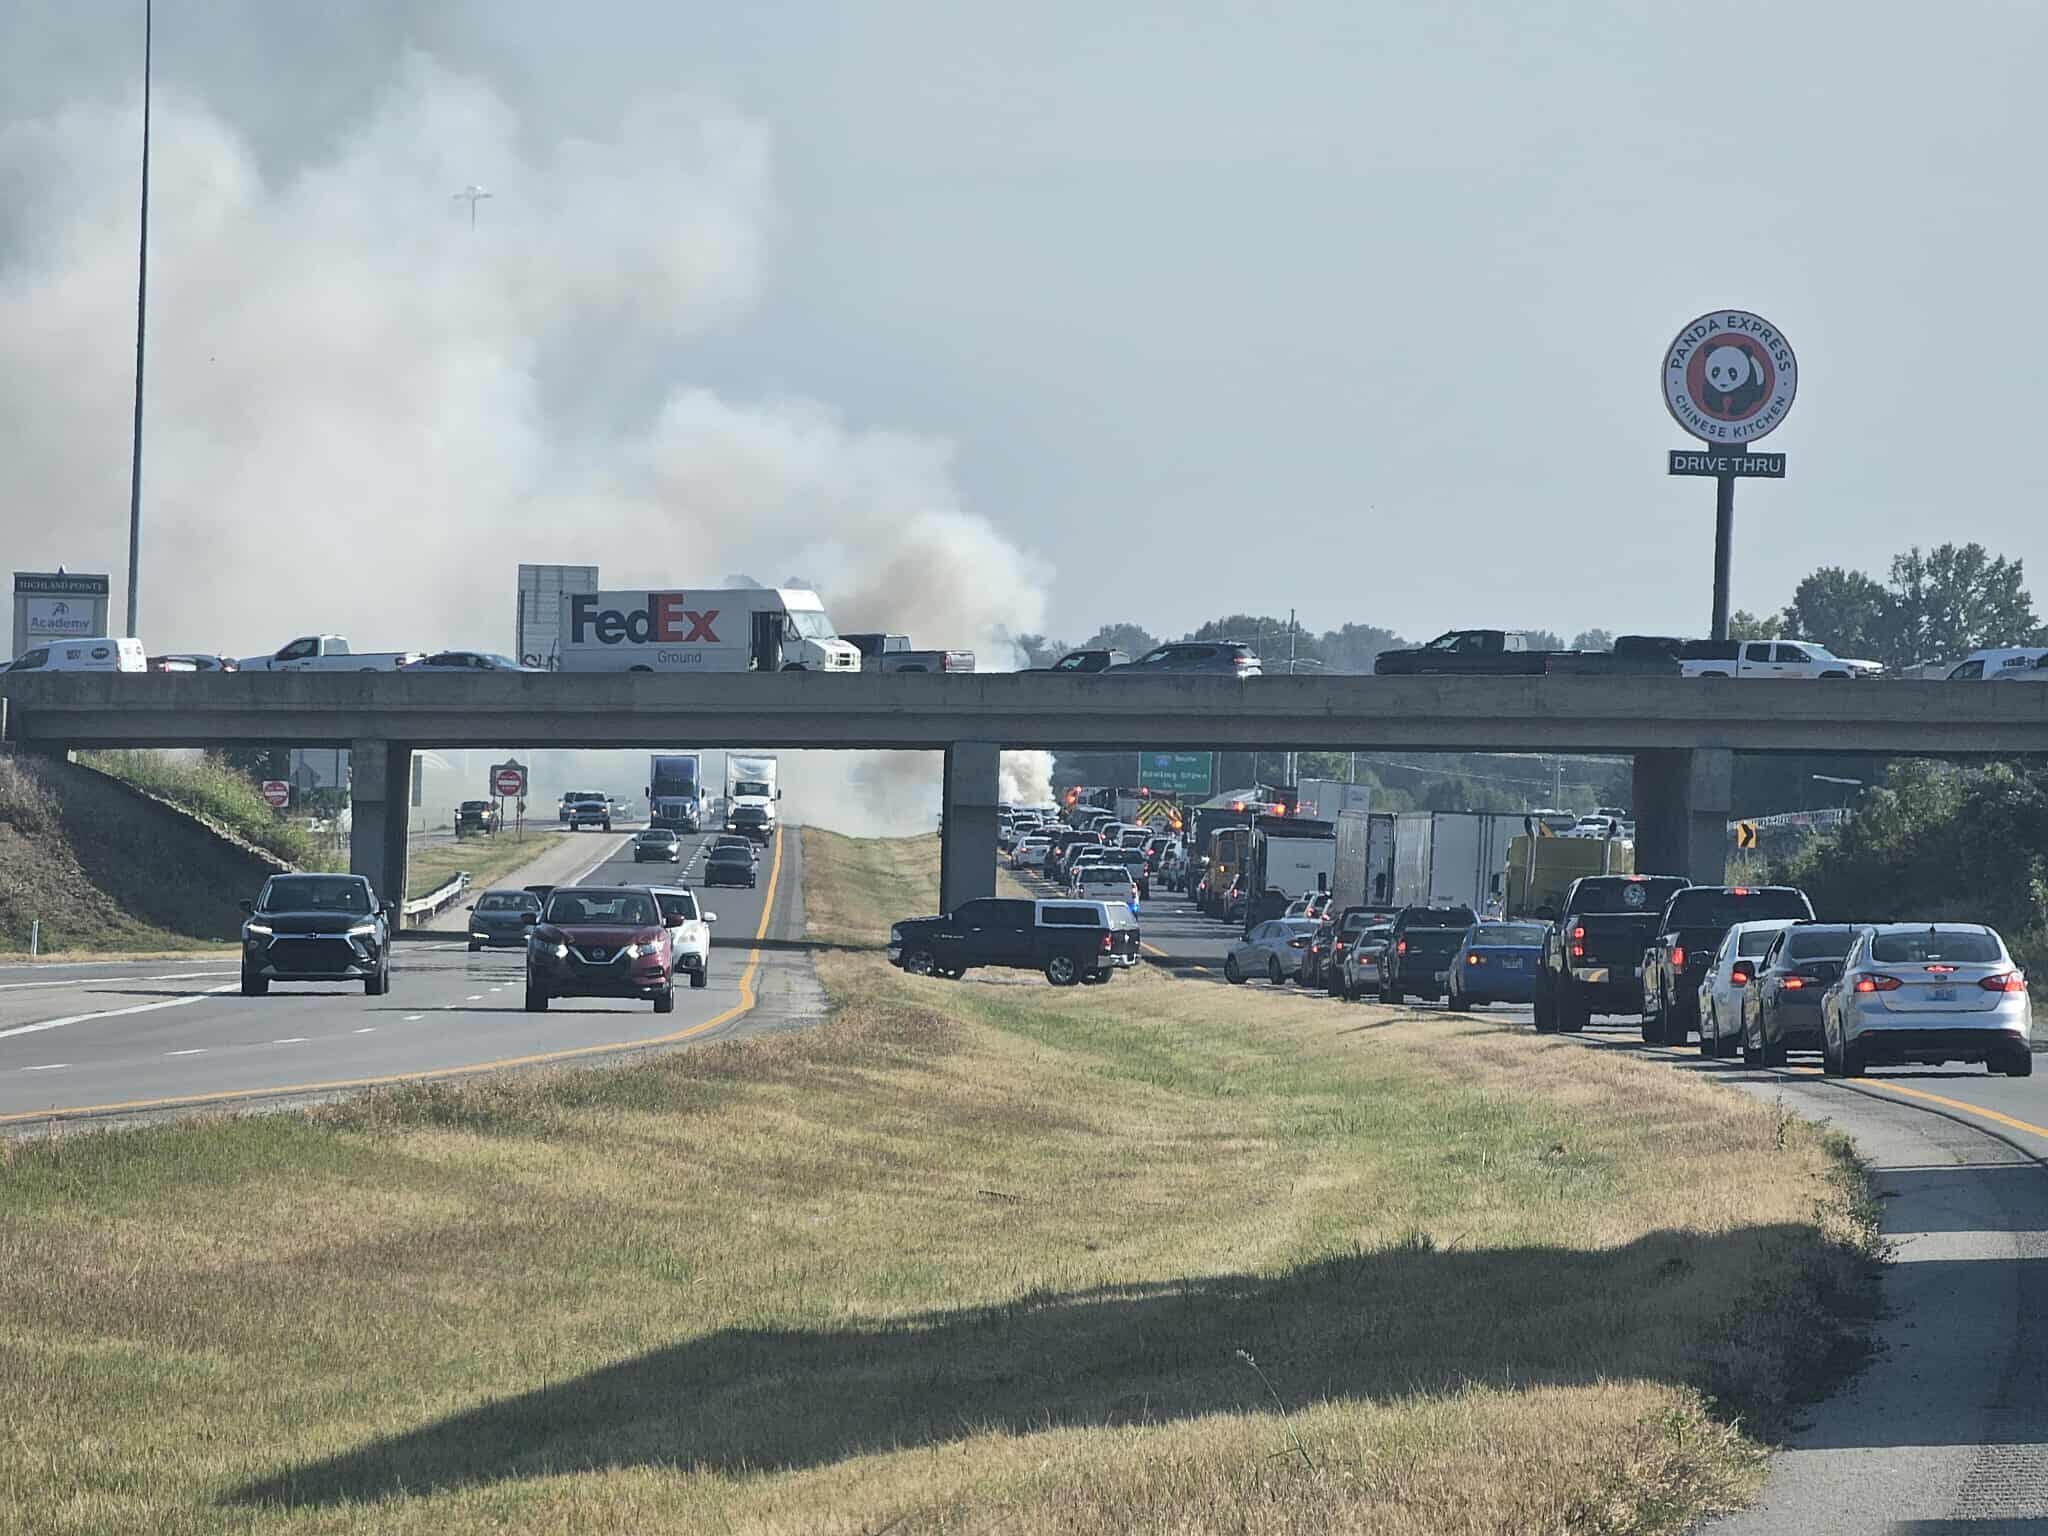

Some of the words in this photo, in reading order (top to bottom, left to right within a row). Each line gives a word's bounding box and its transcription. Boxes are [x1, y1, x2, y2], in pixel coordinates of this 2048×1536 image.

[1671, 319, 1720, 369] PANDA
[1728, 316, 1791, 372] EXPRESS
[1675, 395, 1727, 438] CHINESE
[1733, 396, 1785, 438] KITCHEN
[1674, 456, 1728, 471] DRIVE
[1732, 457, 1781, 473] THRU
[20, 580, 68, 590] HIGHLAND
[31, 617, 89, 629] Academy
[572, 593, 720, 644] FedEx
[657, 650, 702, 664] Ground
